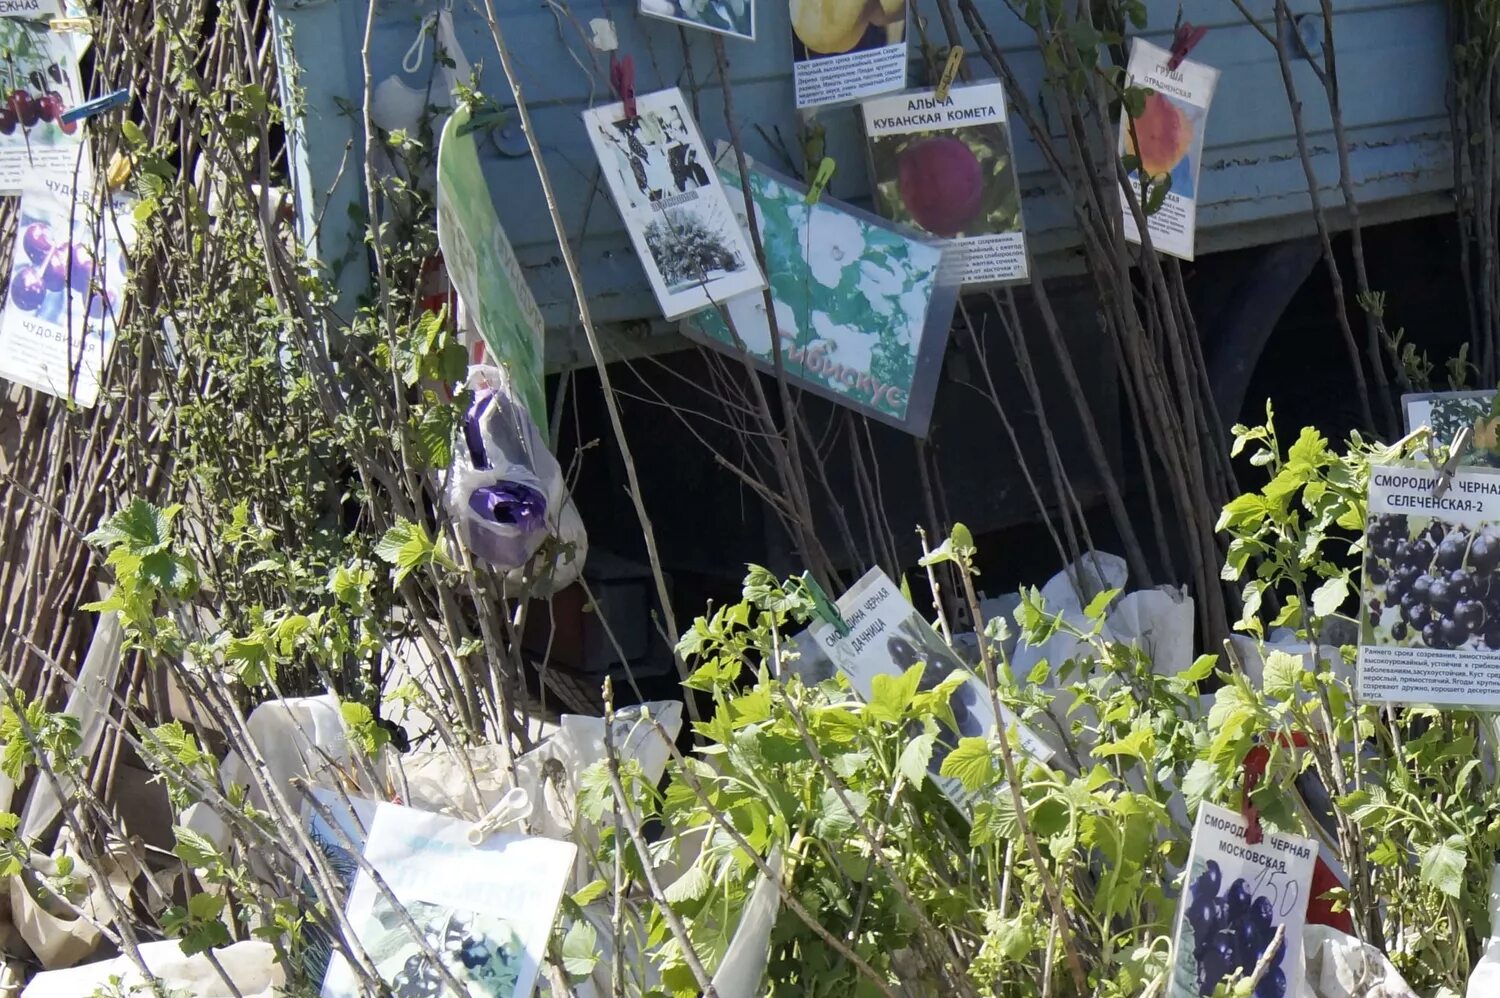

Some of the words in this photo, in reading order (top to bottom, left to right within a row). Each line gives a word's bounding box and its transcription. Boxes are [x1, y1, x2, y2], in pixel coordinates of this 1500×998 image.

[1155, 63, 1184, 83] ГРУША
[907, 95, 954, 111] АЛЫЧА
[873, 112, 942, 129] КУБАНСКАЯ
[947, 106, 996, 121] КОМЕТА
[1374, 474, 1452, 493] СМОРОДИА
[1387, 494, 1483, 512] СЕЛЕЧЕНСКАЯ-2
[825, 608, 866, 648] СМОДИНА
[864, 587, 890, 611] ЧЕРНАЯ
[851, 618, 887, 653] ДАЧНИЦА
[1364, 648, 1392, 656] Раннего
[1417, 652, 1457, 660] созревания,
[1364, 658, 1429, 667] высокоурожайный,
[1431, 661, 1461, 669] устойчив
[1364, 675, 1398, 684] нерослый,
[1452, 678, 1474, 686] Ягоды
[1469, 671, 1483, 679] Куст
[1363, 683, 1399, 691] созревают
[1402, 685, 1429, 693] дружно,
[1431, 686, 1465, 694] хорошего
[1219, 840, 1286, 872] МОСКОВСКАЯ
[1271, 837, 1310, 859] ЧЕРНАЯ
[1251, 866, 1299, 917] 150
